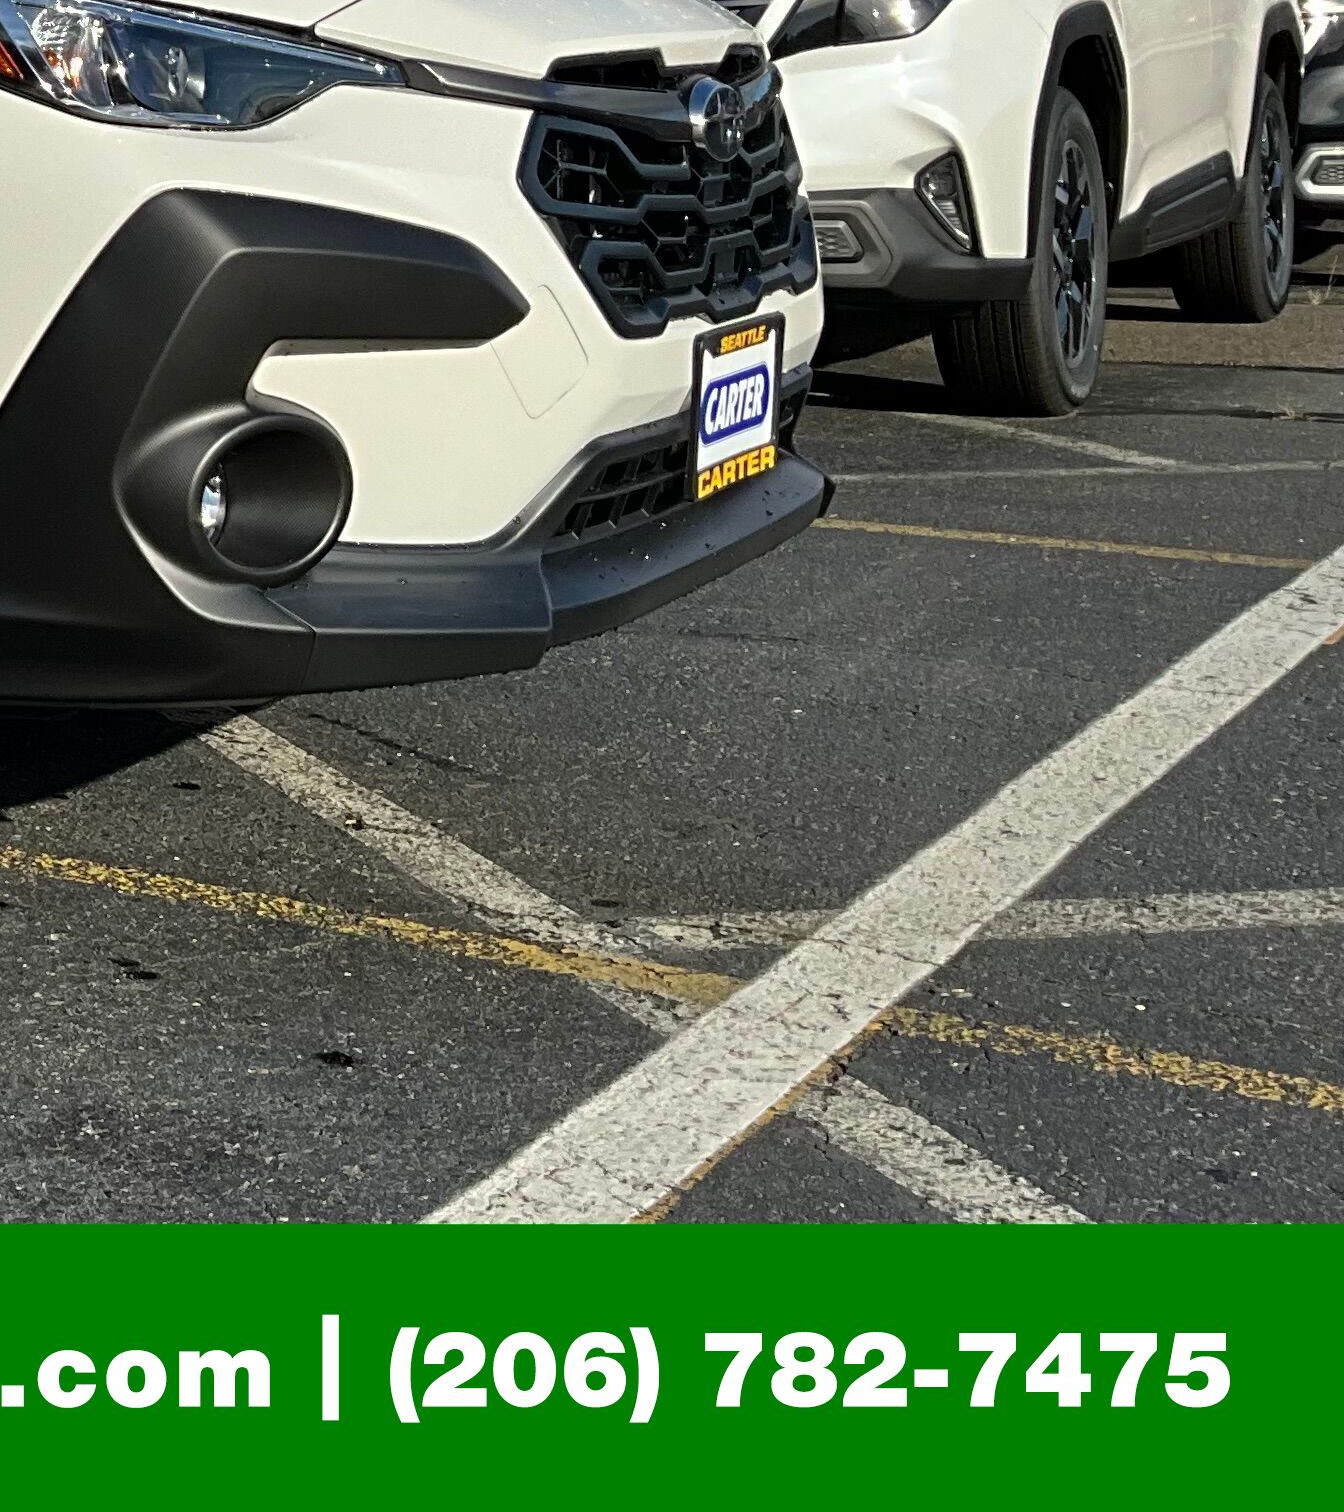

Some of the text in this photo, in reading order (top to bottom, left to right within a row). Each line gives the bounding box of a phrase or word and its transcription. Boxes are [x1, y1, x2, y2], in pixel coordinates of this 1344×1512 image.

[720, 325, 766, 354] SEATTLE
[704, 372, 765, 435] CARTER
[697, 445, 776, 499] CARTER
